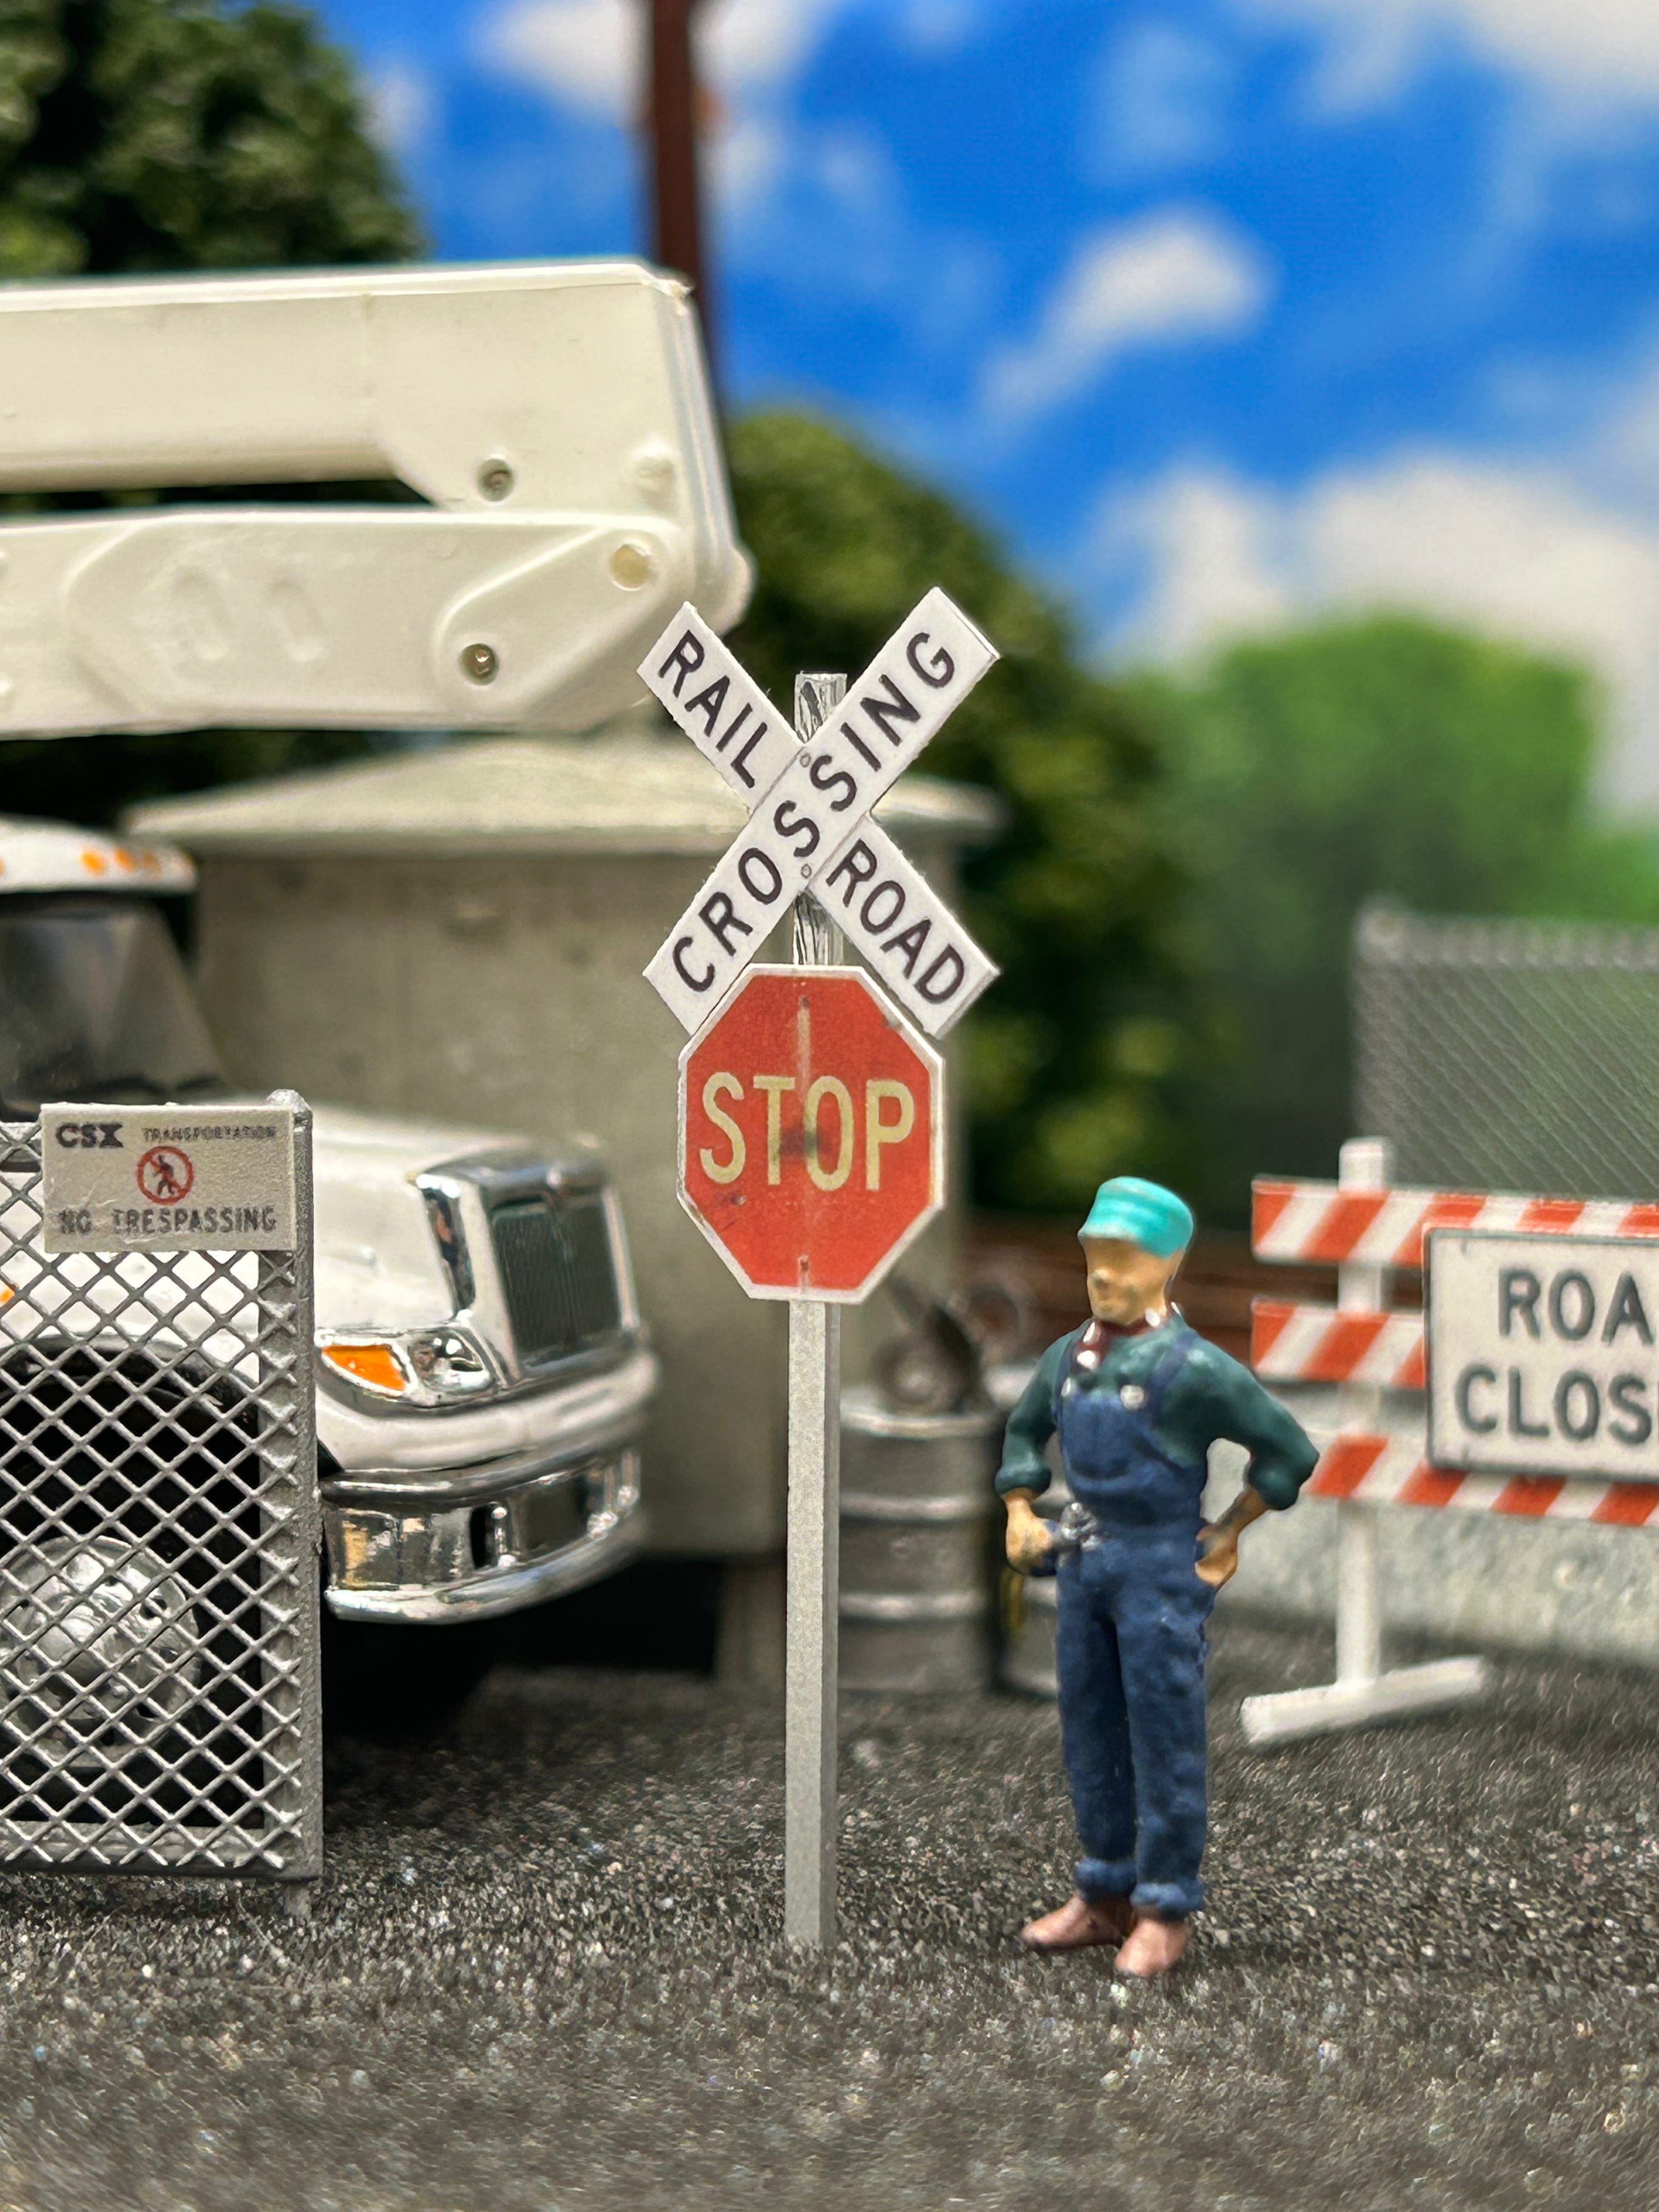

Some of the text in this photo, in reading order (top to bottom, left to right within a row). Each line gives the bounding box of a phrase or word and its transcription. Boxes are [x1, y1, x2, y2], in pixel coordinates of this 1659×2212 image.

[658, 629, 966, 1005] RAIL ROAD
[672, 631, 955, 992] CROSSING
[57, 1122, 123, 1148] CSX
[699, 1072, 915, 1191] STOP
[59, 1206, 276, 1234] NO TRESPASSING
[1498, 1266, 1655, 1346] ROA
[1455, 1363, 1658, 1446] CLOS
